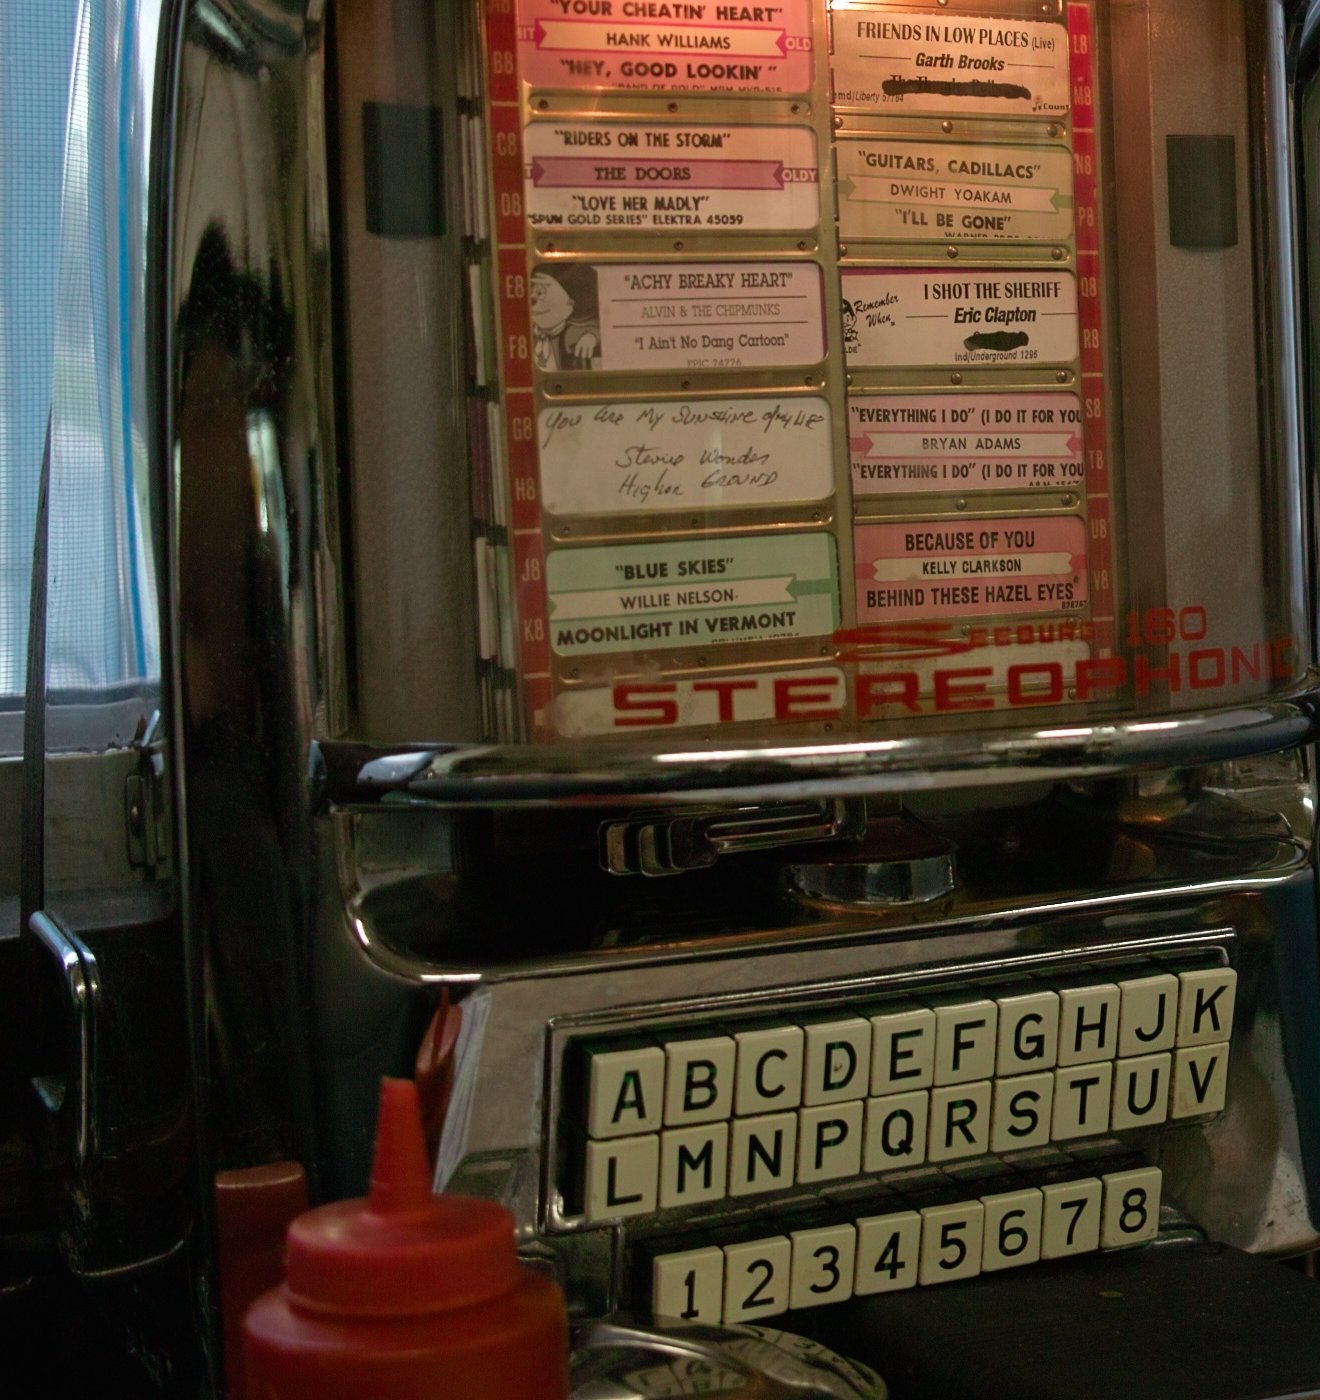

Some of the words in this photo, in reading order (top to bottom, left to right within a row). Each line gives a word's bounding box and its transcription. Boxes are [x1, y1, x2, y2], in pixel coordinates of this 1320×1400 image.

[622, 2, 706, 20] CHEATIN'
[716, 6, 783, 22] HEART"
[606, 32, 650, 47] HANK
[657, 33, 731, 49] WILLIAMS
[856, 21, 922, 41] FRIENDS
[925, 25, 940, 42] IN
[943, 26, 976, 44] LOW
[979, 28, 1029, 48] PLACES
[1031, 37, 1055, 52] (Live)
[1073, 34, 1087, 54] L8
[493, 51, 514, 74] B8
[621, 62, 677, 78] GOOD
[915, 52, 954, 69] Garth
[958, 55, 1005, 72] Brooks
[1074, 86, 1091, 106] M8
[496, 131, 517, 156] C8
[554, 130, 612, 147] "RIDERS
[617, 132, 639, 148] ON
[645, 132, 670, 148] THE
[676, 132, 731, 149] STORM"
[594, 167, 627, 181] THE
[635, 167, 691, 181] DOORS
[947, 159, 1041, 180] CADILLACS"
[1075, 154, 1092, 175] N8
[782, 169, 817, 183] OLDY
[572, 195, 617, 211] "LOVE
[623, 197, 648, 211] HER
[654, 196, 710, 212] MADLY"
[890, 183, 946, 200] DWIGHT
[954, 188, 1012, 204] YOAKAM
[501, 193, 522, 217] D8
[568, 215, 601, 225] GOLD
[605, 214, 649, 225] SERIES"
[653, 215, 702, 225] ELEKTRA
[706, 215, 744, 226] 45059
[936, 213, 954, 228] BE
[961, 215, 1012, 231] GONE"
[1078, 207, 1095, 227] P8
[506, 275, 525, 299] E8
[624, 273, 673, 291] "ACHY
[679, 272, 735, 289] BREAKY
[741, 272, 794, 288] HEART"
[924, 284, 929, 300] I
[932, 283, 972, 300] SHOT
[974, 282, 1001, 299] THE
[1005, 282, 1062, 299] SHERIFF
[1081, 277, 1097, 298] Q8
[641, 305, 676, 319] ALVIN
[680, 305, 689, 317] &
[692, 304, 713, 318] THE
[719, 304, 781, 317] CHIPMUNKS
[854, 292, 899, 314] Remember
[954, 307, 981, 324] Eric
[985, 307, 1037, 326] Clapton
[509, 335, 527, 360] F8
[650, 335, 678, 350] Ain't
[681, 335, 698, 348] No
[701, 335, 734, 352] Dang
[739, 333, 790, 347] Cartoon"
[1083, 329, 1100, 349] R8
[1020, 350, 1038, 360] 1296
[851, 408, 937, 424] "EVERYTHING
[941, 408, 946, 423] I
[951, 407, 975, 423] DO"
[995, 408, 1012, 424] DO
[1016, 408, 1027, 423] IT
[1032, 408, 1055, 423] FOR
[1085, 398, 1101, 419] S8
[512, 416, 533, 441] G8
[922, 437, 967, 451] BRYAN
[975, 437, 1022, 451] ADAMS
[1088, 450, 1104, 470] T8
[852, 463, 938, 480] "EVERYTHING
[942, 465, 947, 479] I
[951, 463, 976, 479] DO"
[996, 464, 1013, 479] DO
[1017, 464, 1028, 478] IT
[1033, 464, 1056, 478] FOR
[1060, 463, 1084, 478] YOU
[515, 477, 536, 501] H8
[905, 533, 974, 551] BECAUSE
[979, 532, 1000, 550] OF
[1004, 531, 1036, 549] YOU
[521, 558, 541, 582] J8
[615, 563, 668, 580] "BLUE
[678, 558, 734, 576] SKIES"
[922, 560, 958, 576] KELLY
[962, 559, 1022, 574] CLARKSON
[1093, 570, 1109, 591] V8
[620, 593, 671, 610] WILLIE
[677, 588, 734, 606] NELSON
[866, 588, 925, 609] BEHIND
[930, 586, 980, 606] THESE
[985, 584, 1032, 603] HAZEL
[1037, 583, 1074, 602] EYES
[524, 617, 545, 642] K8
[556, 622, 673, 647] MOONLIGHT
[679, 619, 698, 636] IN
[704, 611, 797, 633] VERMONT
[612, 636, 1293, 728] STEREOPHONIC
[612, 1069, 647, 1124] A
[684, 1059, 718, 1111] B
[754, 1048, 788, 1099] C
[823, 1042, 856, 1091] D
[890, 1031, 923, 1081] E
[952, 1020, 986, 1071] F
[1013, 1013, 1045, 1061] G
[1076, 1003, 1107, 1053] H
[1134, 993, 1167, 1043] J
[1192, 985, 1228, 1034] K
[607, 1156, 643, 1207] L
[677, 1139, 712, 1193] M
[747, 1129, 783, 1182] N
[816, 1119, 849, 1169] P
[881, 1109, 914, 1158] Q
[945, 1098, 978, 1149] R
[1008, 1090, 1041, 1138] S
[1069, 1078, 1099, 1125] T
[1127, 1068, 1158, 1116] U
[1187, 1056, 1217, 1105] V
[680, 1270, 699, 1320] 1
[742, 1260, 775, 1310] 2
[808, 1246, 841, 1295] 3
[873, 1232, 905, 1281] 4
[939, 1222, 968, 1271] 5
[1000, 1209, 1029, 1258] 6
[1060, 1199, 1088, 1246] 7
[1118, 1187, 1147, 1233] 8
